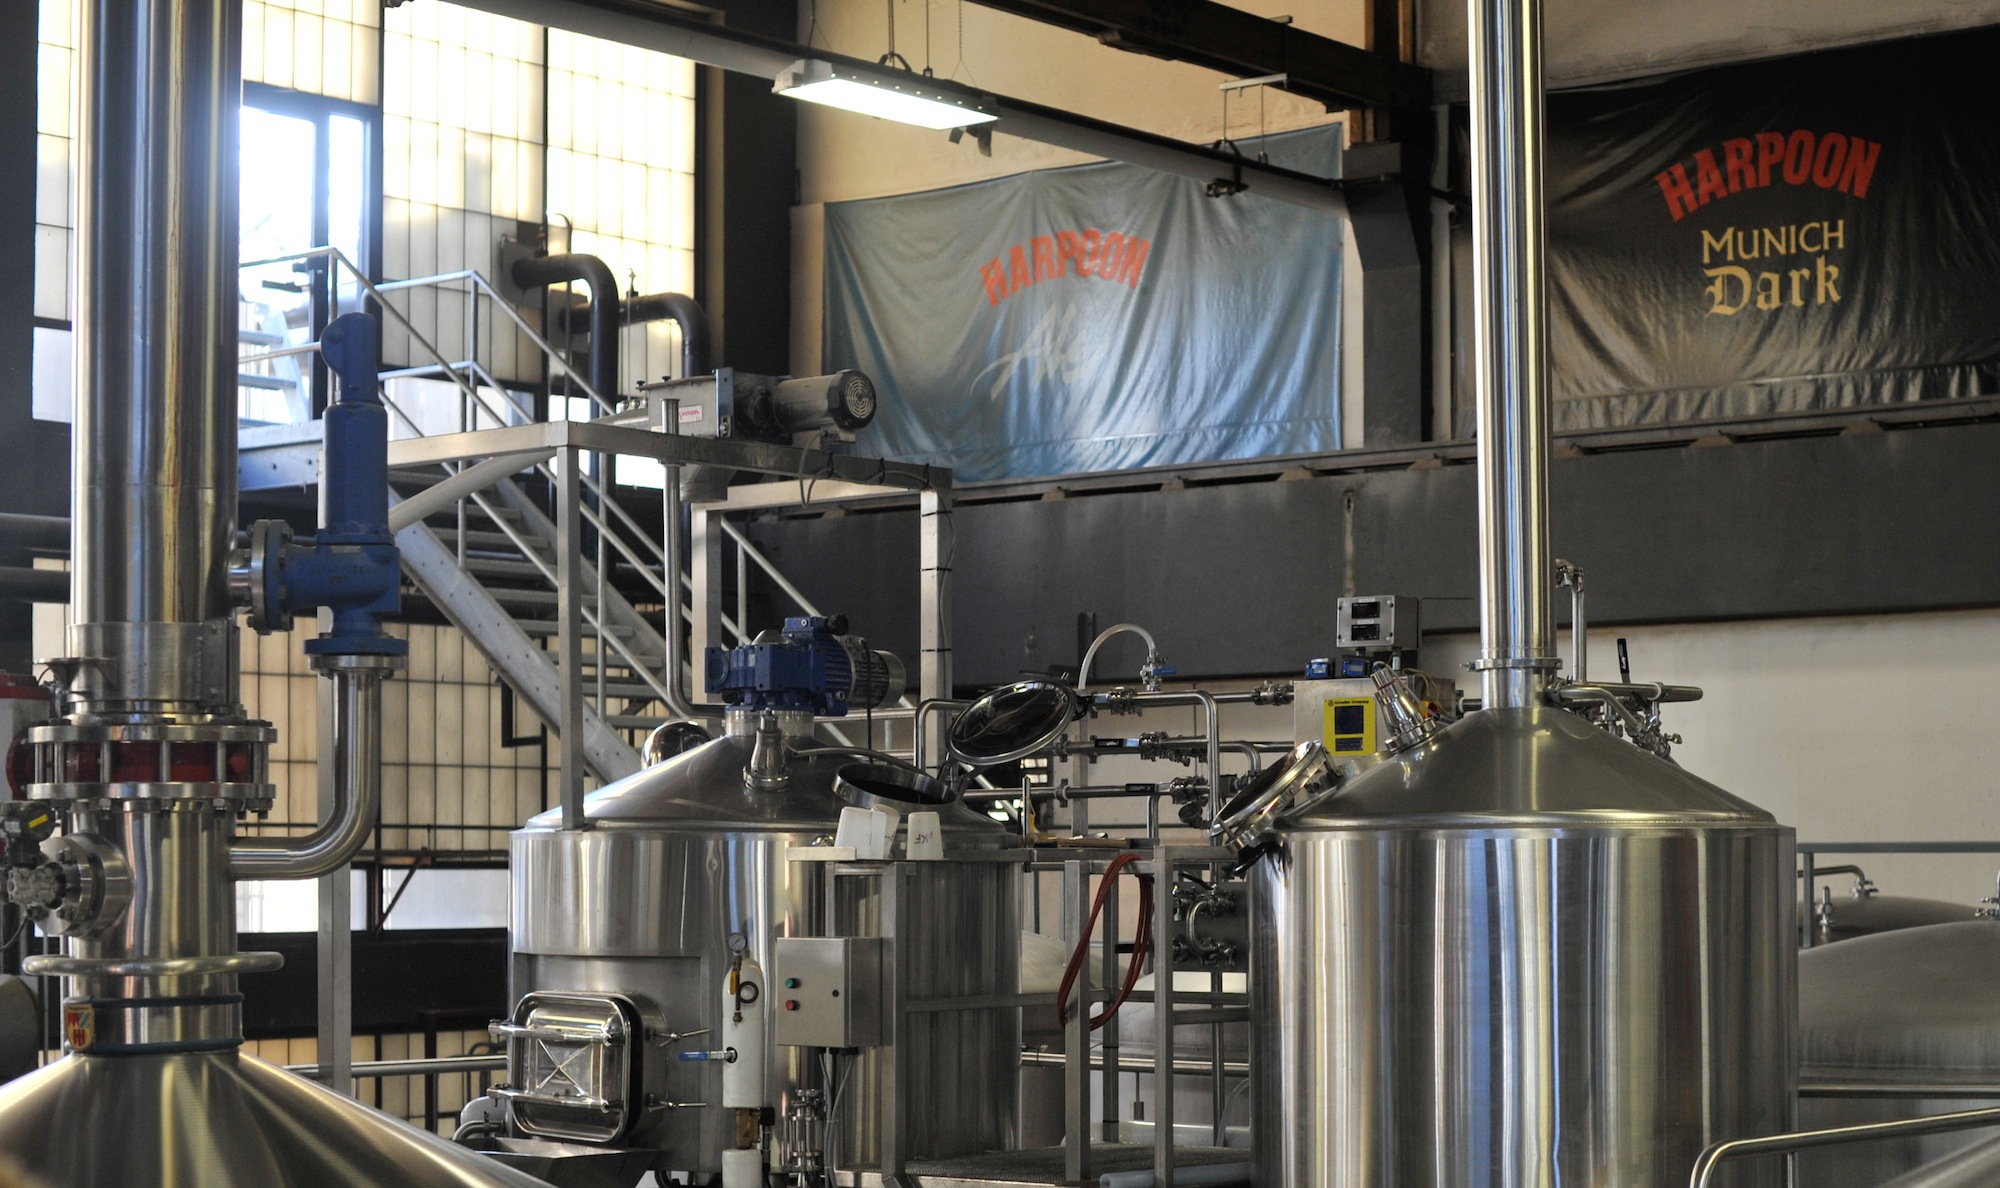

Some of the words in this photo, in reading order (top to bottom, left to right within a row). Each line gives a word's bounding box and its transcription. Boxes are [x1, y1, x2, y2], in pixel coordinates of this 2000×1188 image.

[1656, 129, 1882, 222] HARPOON
[980, 227, 1151, 307] HARPOON
[1701, 219, 1845, 264] MUNICH
[1704, 255, 1842, 318] Dark
